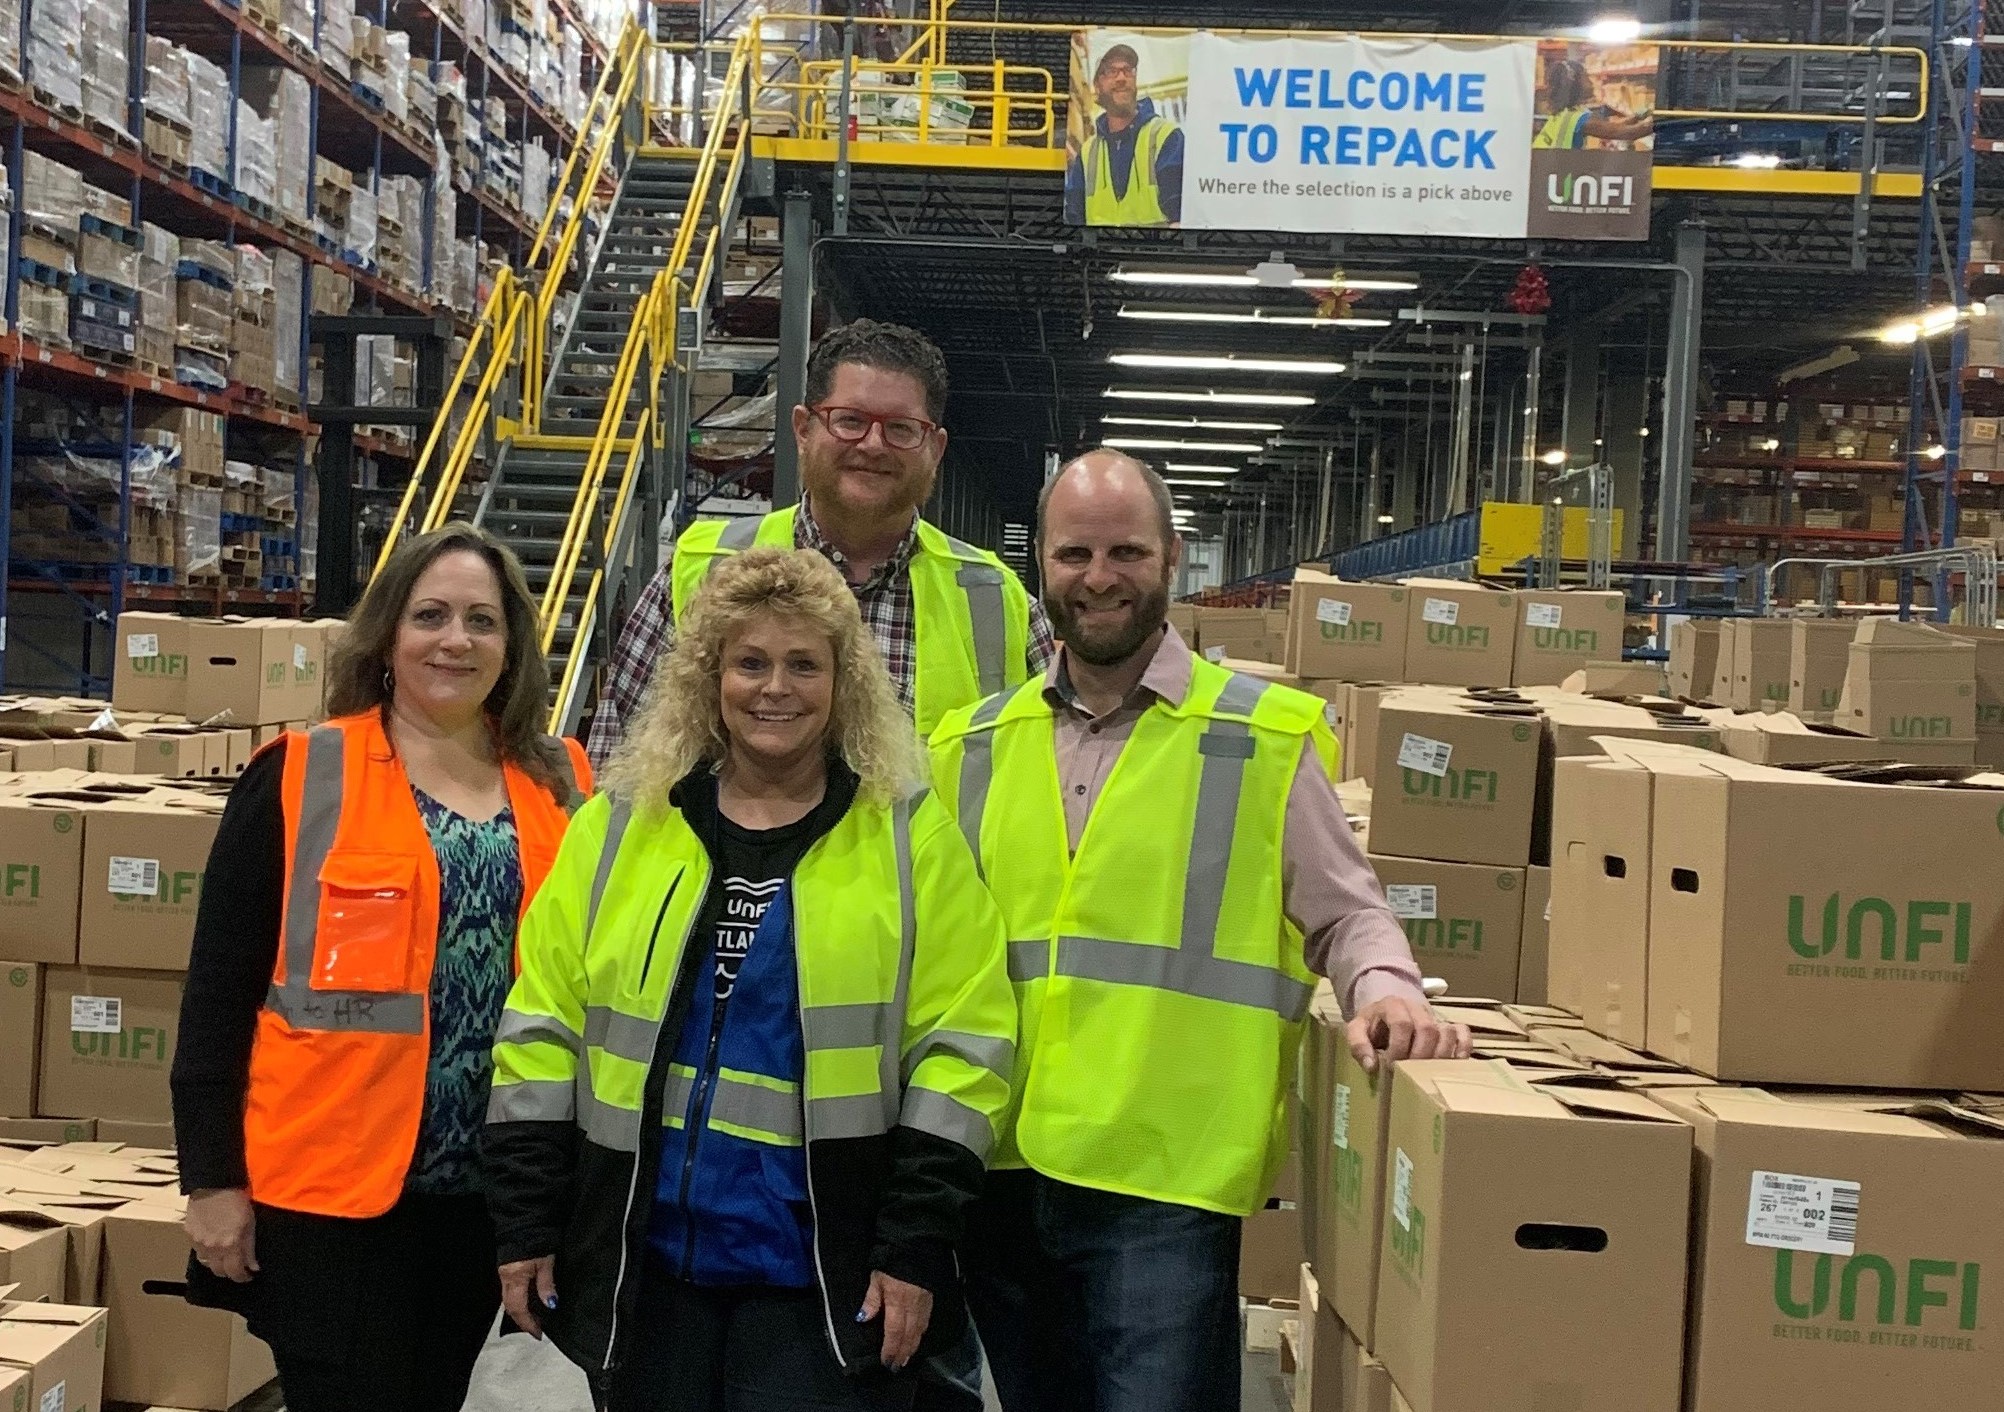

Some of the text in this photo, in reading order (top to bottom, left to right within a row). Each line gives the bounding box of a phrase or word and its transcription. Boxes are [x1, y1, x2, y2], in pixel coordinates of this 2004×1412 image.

[1234, 67, 1486, 112] WELCOME
[1219, 123, 1498, 169] TO REPACK
[1198, 177, 1512, 202] Where the selection is a pick above
[1547, 172, 1633, 205] UNFI
[727, 898, 772, 919] UNF
[1787, 890, 1972, 964] UNFI
[1760, 1202, 1778, 1213] 267
[1816, 1190, 1822, 1201] 1
[1803, 1207, 1826, 1221] 002
[1773, 1248, 1981, 1331] UNFI
[1772, 1323, 1822, 1341] BETTER
[1869, 1330, 1918, 1347] BETTER
